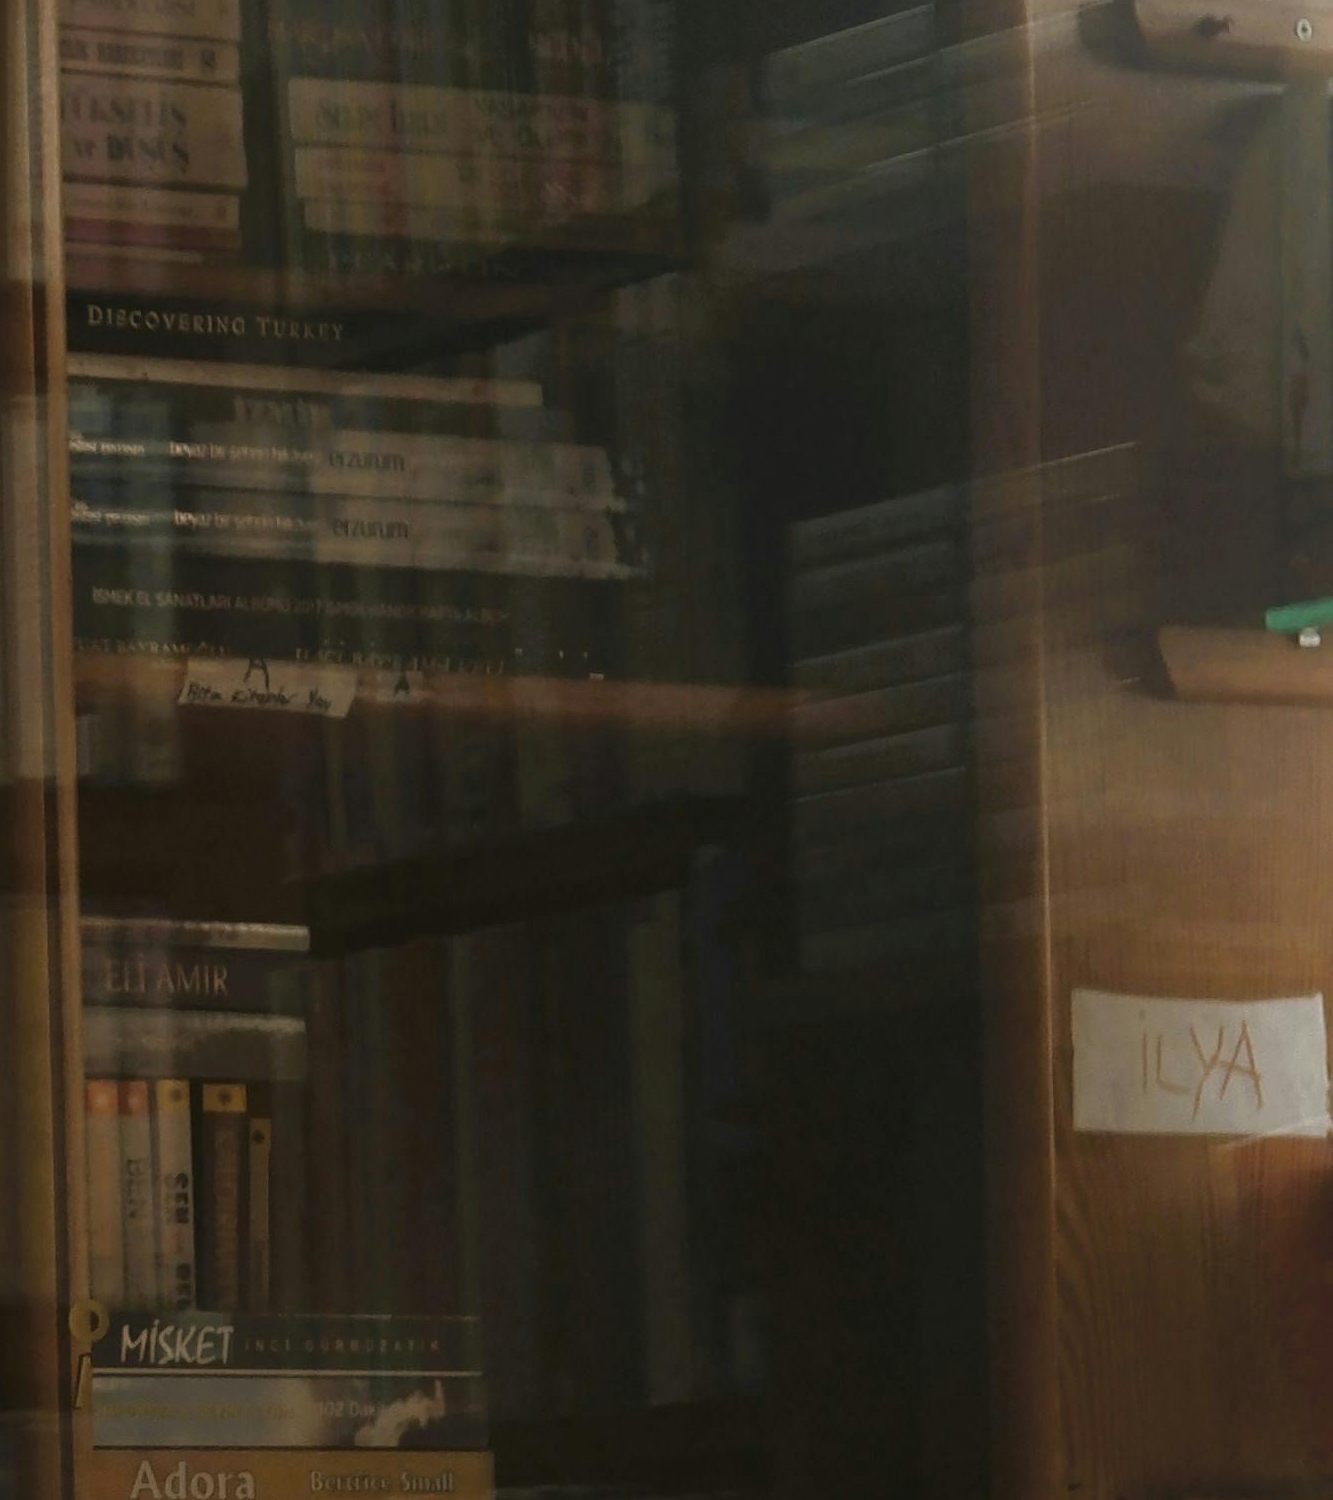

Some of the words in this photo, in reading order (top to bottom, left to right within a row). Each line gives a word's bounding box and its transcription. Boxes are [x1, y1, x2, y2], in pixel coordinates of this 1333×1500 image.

[88, 303, 247, 338] DISCOVERING
[255, 314, 346, 343] TURKEY
[120, 1319, 235, 1367] MİSKET
[130, 1459, 257, 1500] Adora
